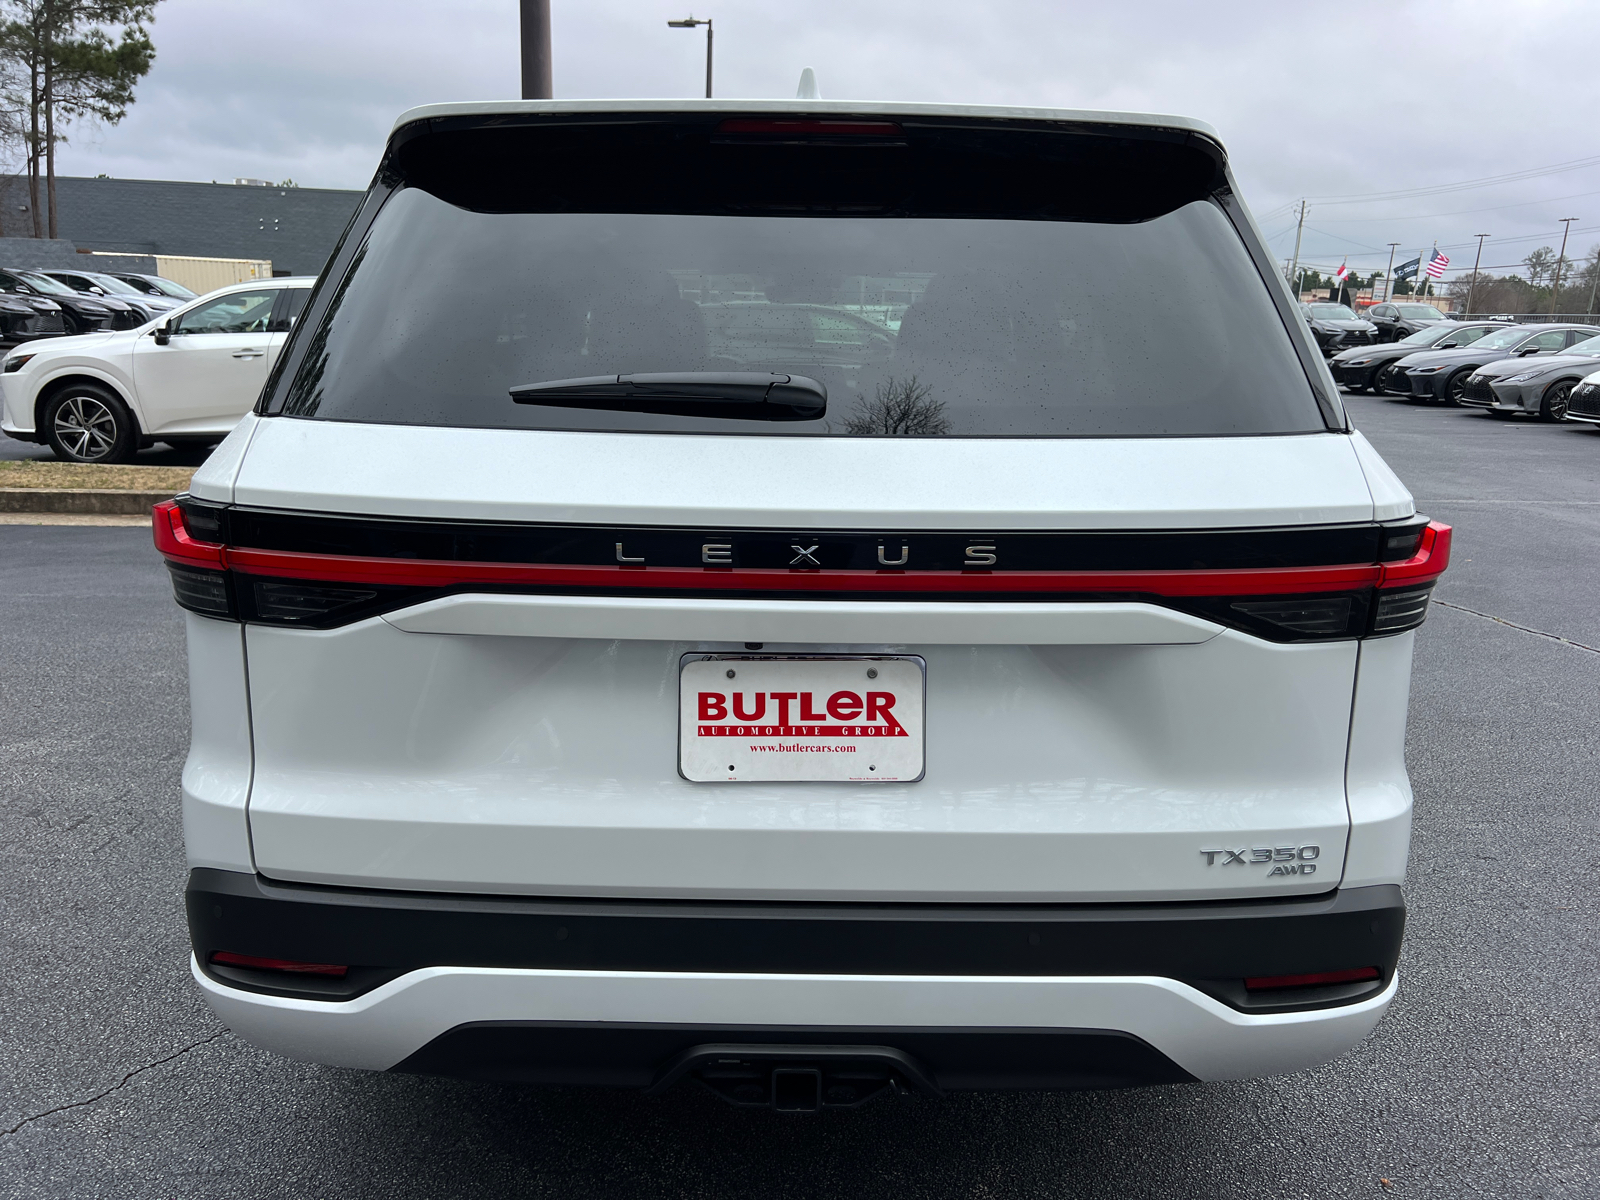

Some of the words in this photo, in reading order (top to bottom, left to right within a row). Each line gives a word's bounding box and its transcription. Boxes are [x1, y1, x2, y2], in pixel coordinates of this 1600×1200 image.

[615, 542, 998, 566] LEXUS
[699, 726, 821, 736] AUTOMOTIVE
[842, 726, 902, 736] GROUP
[749, 742, 857, 754] www.butlercars.com
[1266, 863, 1317, 877] AWD
